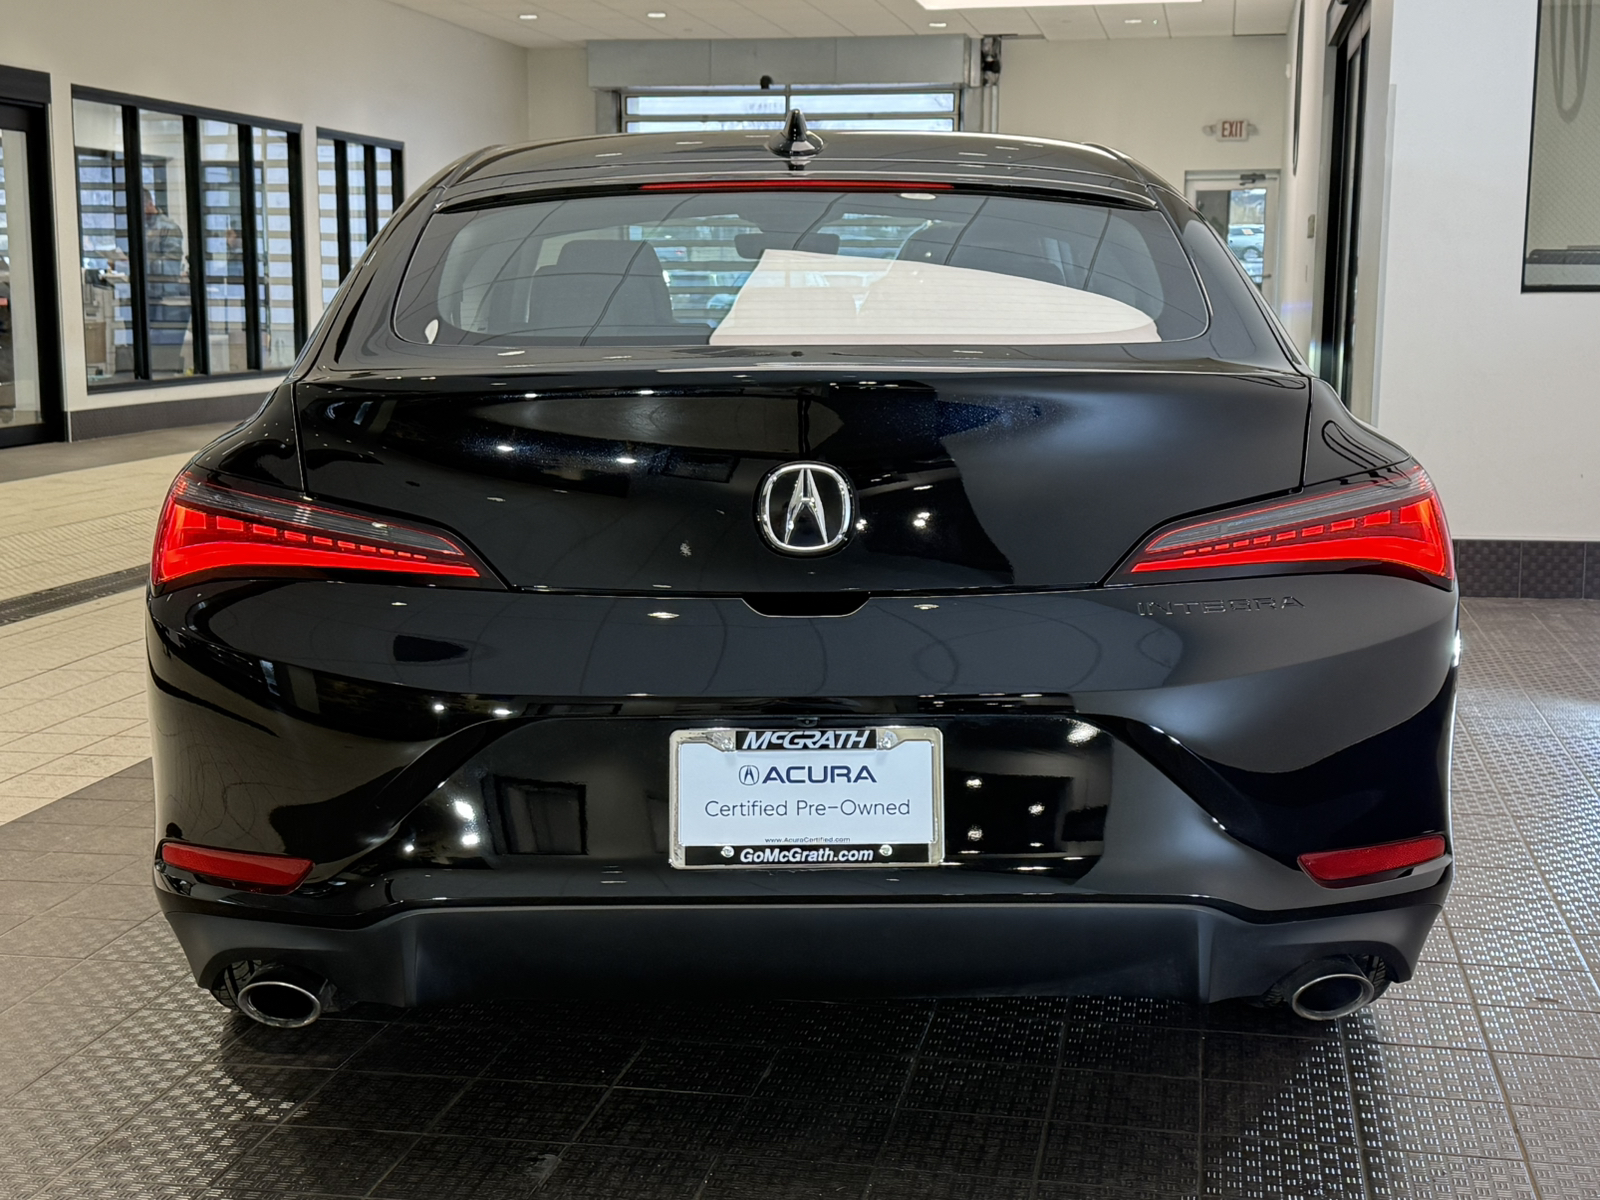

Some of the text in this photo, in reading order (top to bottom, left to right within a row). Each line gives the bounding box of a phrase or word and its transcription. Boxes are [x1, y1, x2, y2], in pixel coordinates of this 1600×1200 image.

[1221, 120, 1244, 138] EXIT
[1137, 596, 1306, 616] INTEGRA
[762, 765, 877, 784] ACURA
[704, 799, 910, 817] Certified Pre-Owned
[740, 847, 874, 863] GoMcGrath.com
